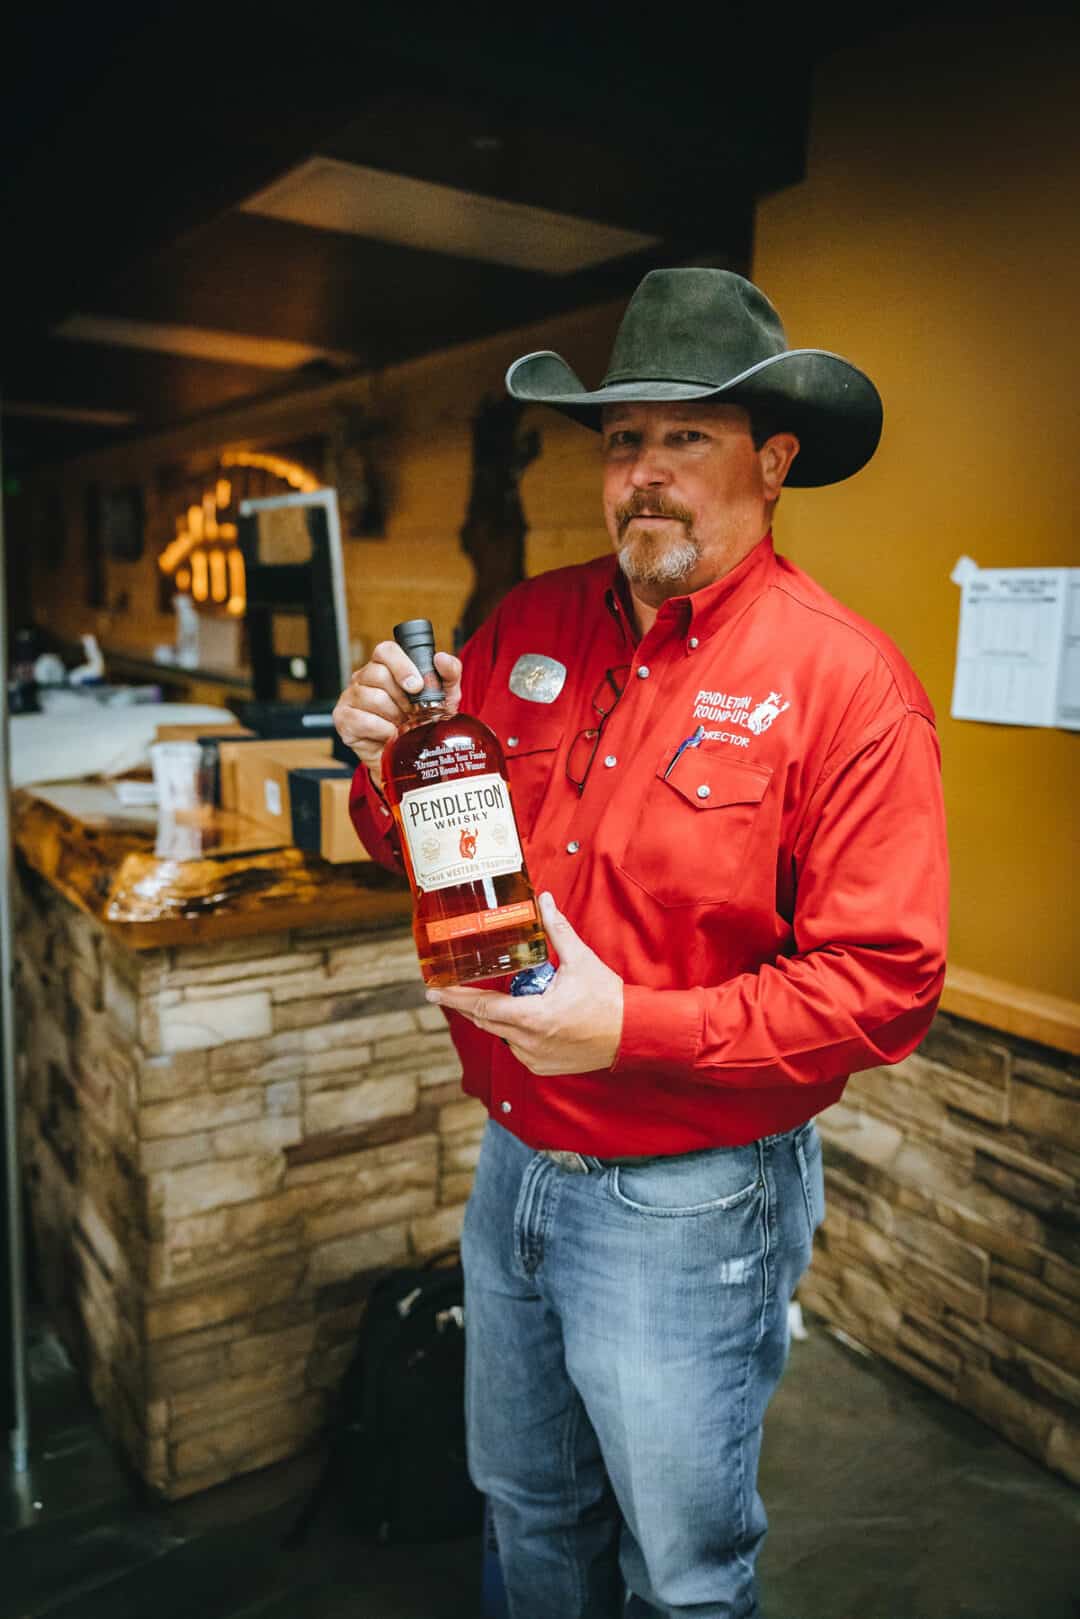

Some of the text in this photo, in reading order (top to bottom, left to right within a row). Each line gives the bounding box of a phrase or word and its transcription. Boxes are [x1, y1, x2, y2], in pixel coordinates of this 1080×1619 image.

[694, 690, 752, 709] PENDLETON
[421, 768, 439, 780] 2023
[460, 763, 465, 772] 3
[409, 784, 504, 827] PENDLETON
[434, 811, 488, 830] WHISKY
